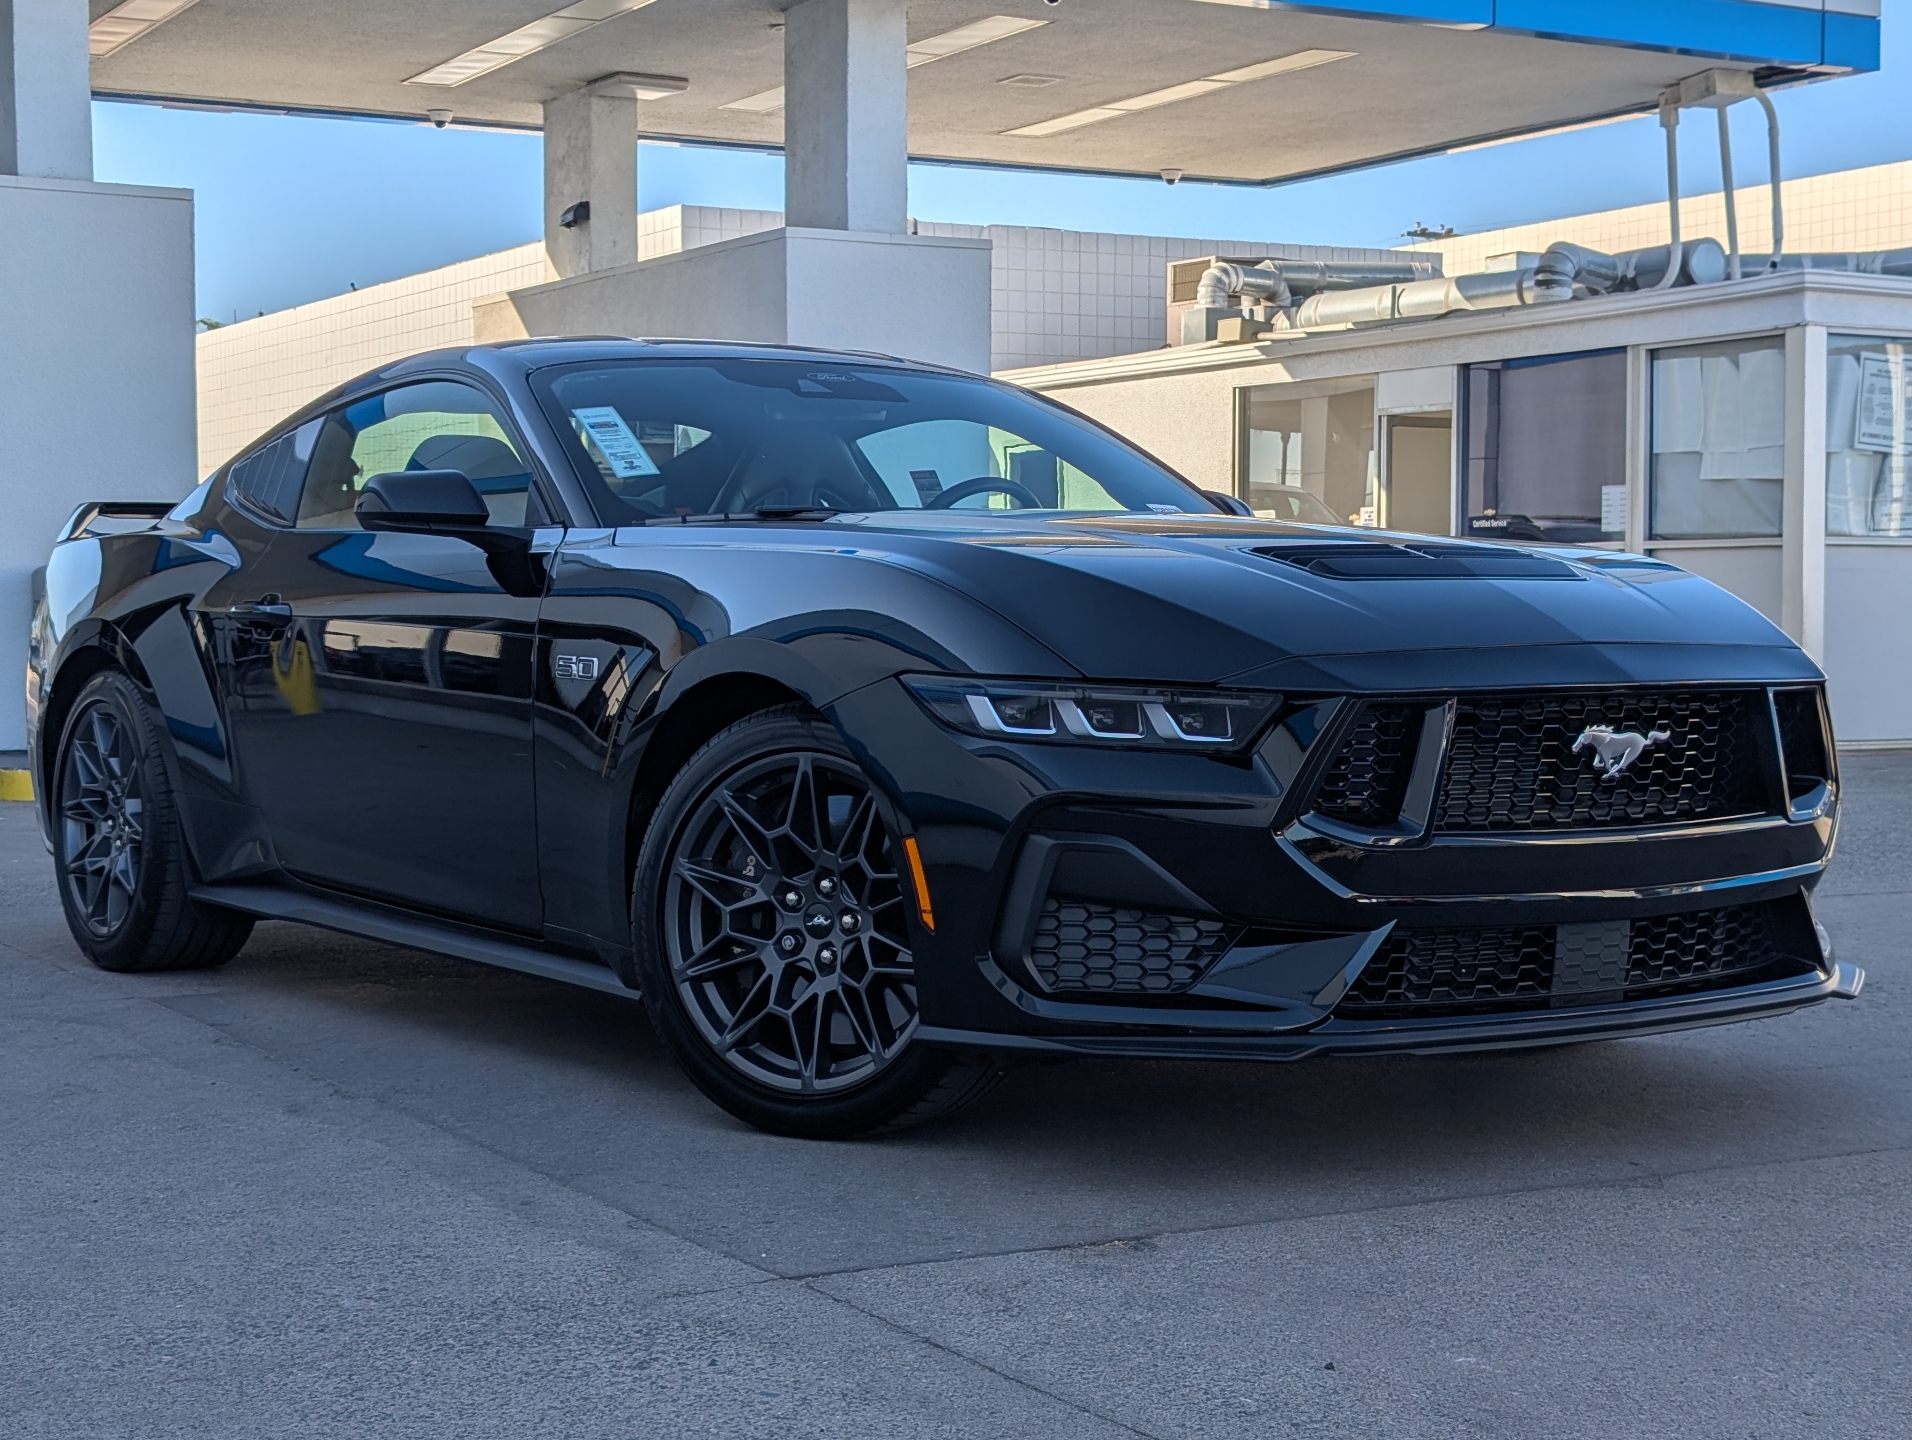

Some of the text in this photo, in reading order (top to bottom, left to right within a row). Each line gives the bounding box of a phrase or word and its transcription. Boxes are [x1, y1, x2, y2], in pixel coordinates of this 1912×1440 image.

[815, 372, 849, 382] Ford
[1472, 518, 1507, 528] Certified Service
[556, 655, 599, 681] 5.0
